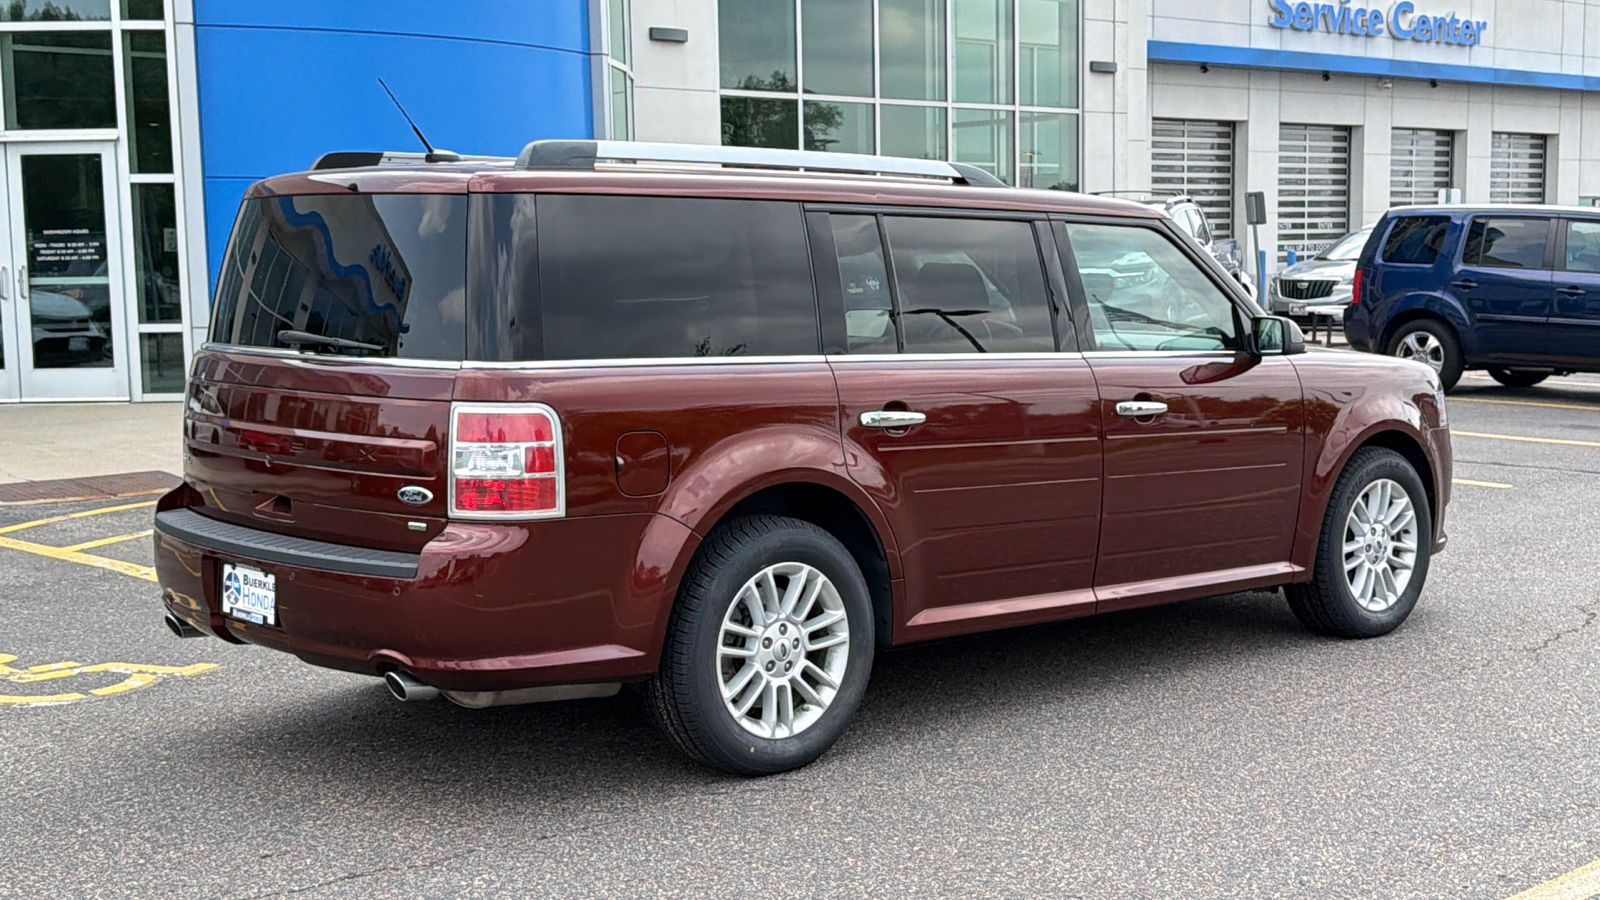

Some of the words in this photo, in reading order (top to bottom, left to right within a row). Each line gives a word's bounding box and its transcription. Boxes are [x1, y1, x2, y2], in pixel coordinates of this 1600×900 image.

[1269, 0, 1384, 36] Service
[1389, 1, 1488, 45] Center
[243, 573, 275, 592] BUERKLE
[243, 586, 275, 611] HONDA
